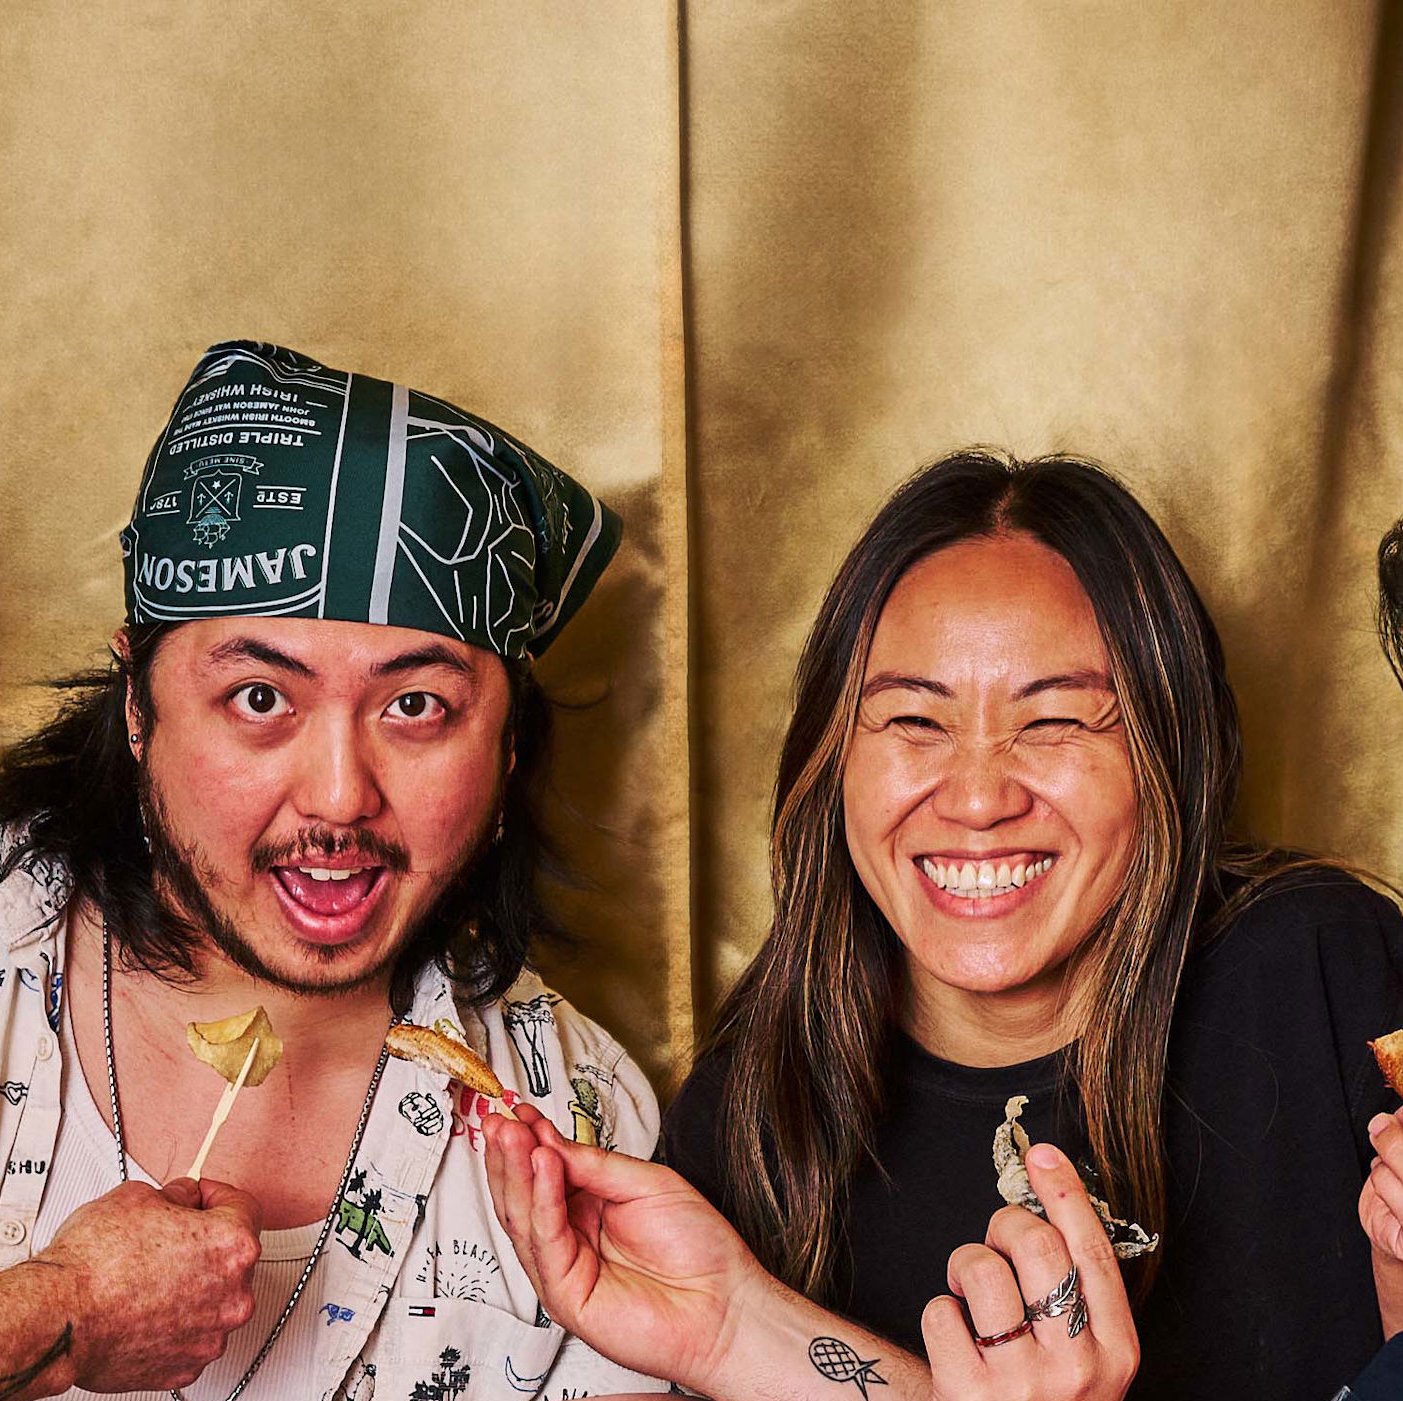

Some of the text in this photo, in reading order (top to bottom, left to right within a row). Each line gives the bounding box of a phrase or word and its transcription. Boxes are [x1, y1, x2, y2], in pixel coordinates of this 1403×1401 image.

[193, 383, 298, 406] IRISH WHISKEY
[214, 401, 230, 411] WAY
[234, 401, 279, 410] JAMESON
[281, 404, 309, 415] JOHN
[203, 413, 239, 425] WHISKEY
[270, 413, 314, 427] SMOOTH
[169, 432, 302, 455] TRIPLE DISTILLED
[139, 543, 316, 594] JAMESON
